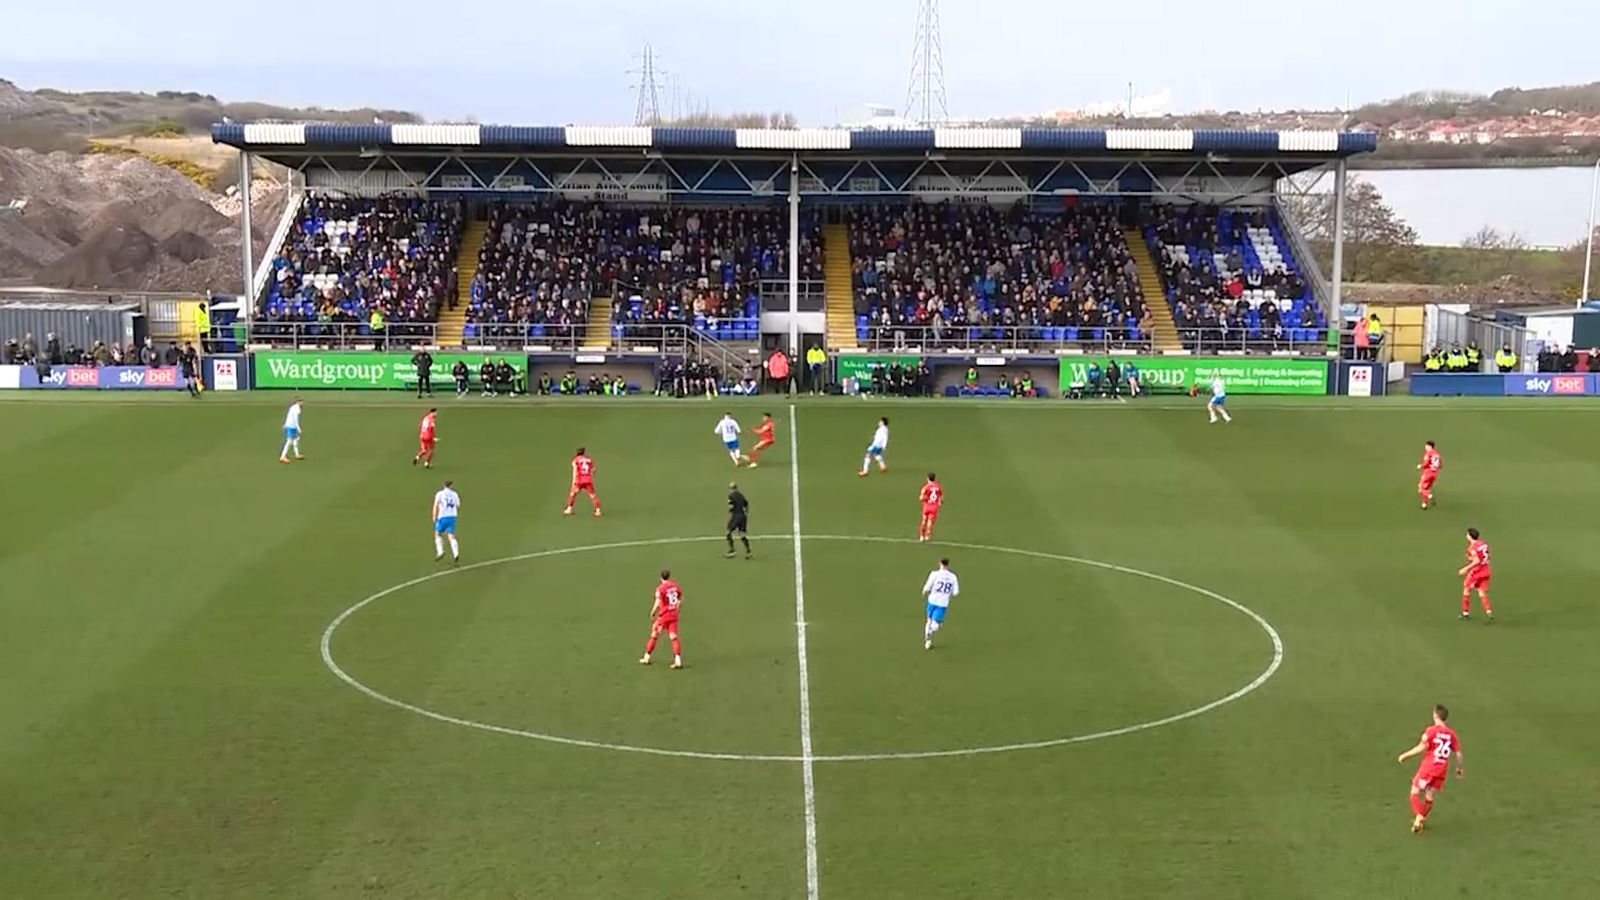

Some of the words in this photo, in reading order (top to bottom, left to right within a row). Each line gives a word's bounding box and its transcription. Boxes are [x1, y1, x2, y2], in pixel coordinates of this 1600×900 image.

[70, 369, 96, 382] bet
[119, 369, 145, 384] sky
[148, 369, 172, 382] bet
[267, 358, 384, 384] Wardgroup
[1525, 378, 1551, 393] sky
[1555, 378, 1581, 390] bet
[930, 490, 938, 502] 6
[936, 581, 953, 594] 28
[1433, 738, 1452, 758] 26
